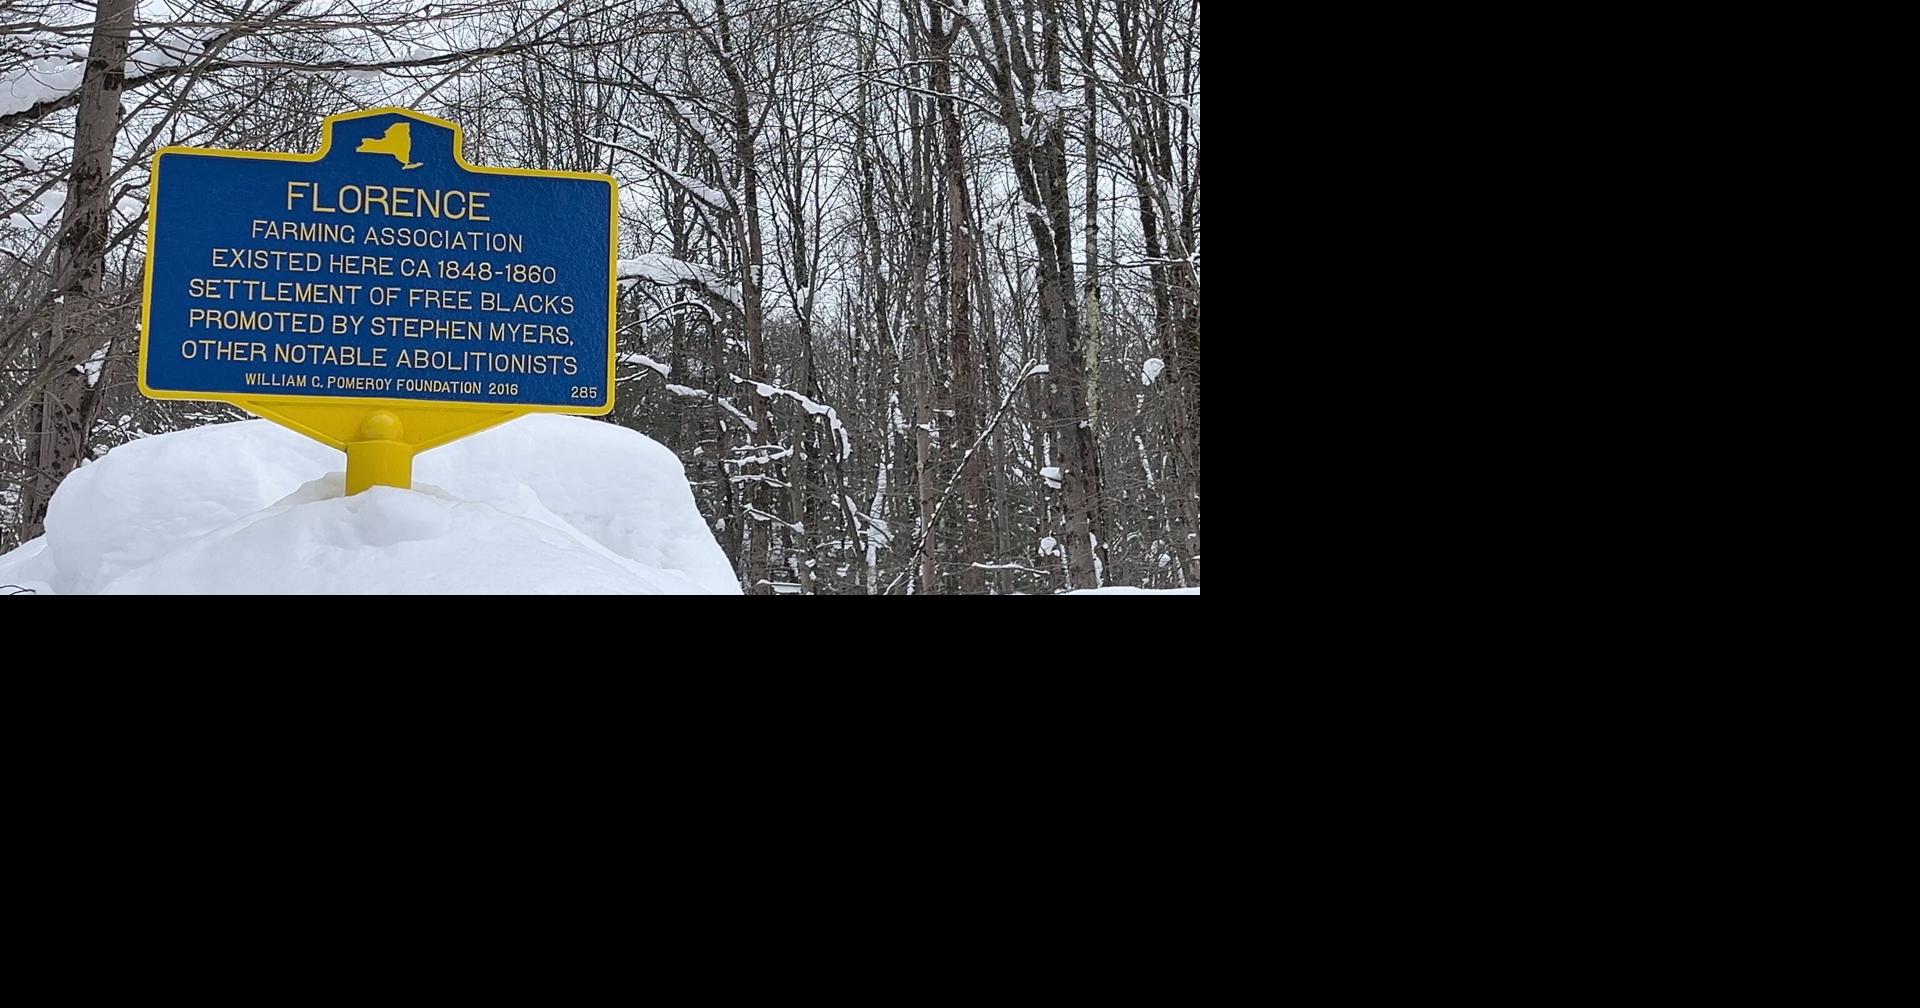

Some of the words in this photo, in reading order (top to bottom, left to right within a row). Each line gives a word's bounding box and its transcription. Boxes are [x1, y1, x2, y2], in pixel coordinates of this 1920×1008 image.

[287, 181, 490, 221] FLORENCE
[252, 219, 355, 244] FARMING
[363, 226, 522, 253] ASSOCIATION
[212, 248, 322, 272] EXISTED
[329, 254, 394, 276] HERE
[400, 258, 432, 278] CA
[438, 260, 556, 285] 1848-1860
[188, 278, 362, 305] SETTLEMENT
[369, 286, 402, 306] OF
[409, 288, 473, 310] FREE
[481, 291, 574, 315] BLACKS
[189, 308, 325, 334] PROMOTED
[332, 314, 364, 335] BY
[370, 316, 482, 341] STEPHEN
[489, 322, 574, 346] MYERS,
[181, 339, 267, 362] OTHER
[274, 343, 387, 367] NOTABLE
[396, 349, 578, 375] ABOLITIONISTS
[245, 372, 307, 387] WILLIAM
[311, 375, 324, 388] C.
[327, 376, 393, 391] POMEROY
[396, 378, 482, 394] FOUNDATION
[488, 382, 519, 396] 2016
[571, 386, 597, 399] 285
